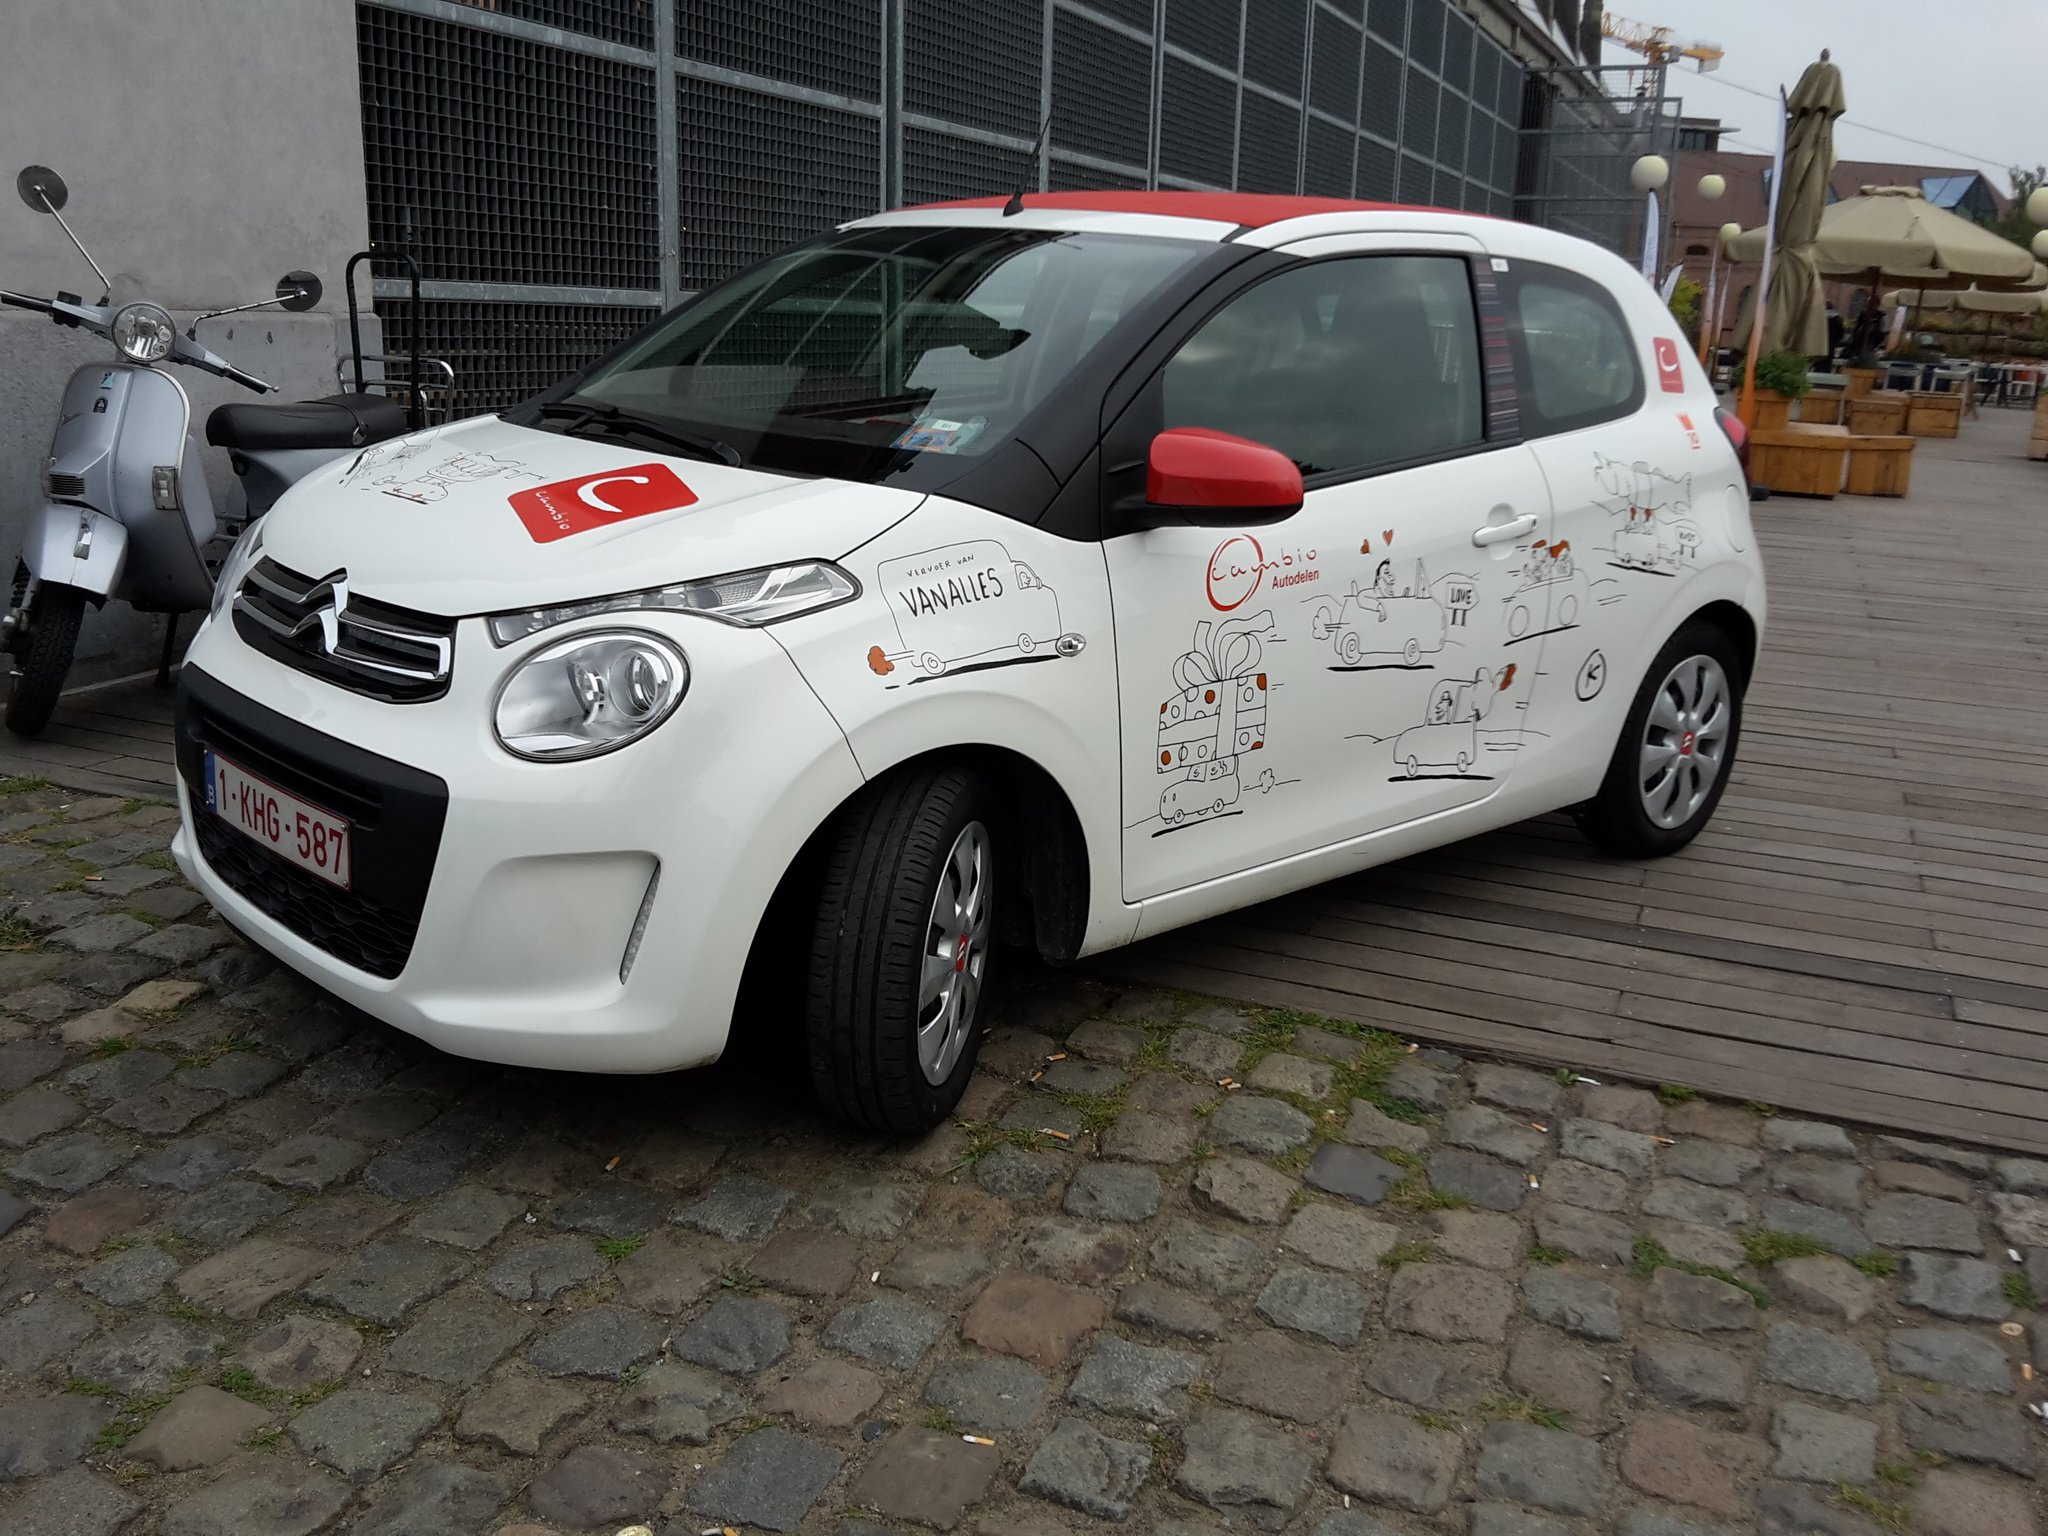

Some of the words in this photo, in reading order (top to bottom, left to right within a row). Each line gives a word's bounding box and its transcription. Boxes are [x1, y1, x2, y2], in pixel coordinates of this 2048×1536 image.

[906, 559, 952, 578] VERVOER
[956, 553, 976, 566] VAN
[1271, 568, 1320, 590] Autodelen
[898, 567, 1004, 618] VANALLES
[207, 784, 216, 805] B
